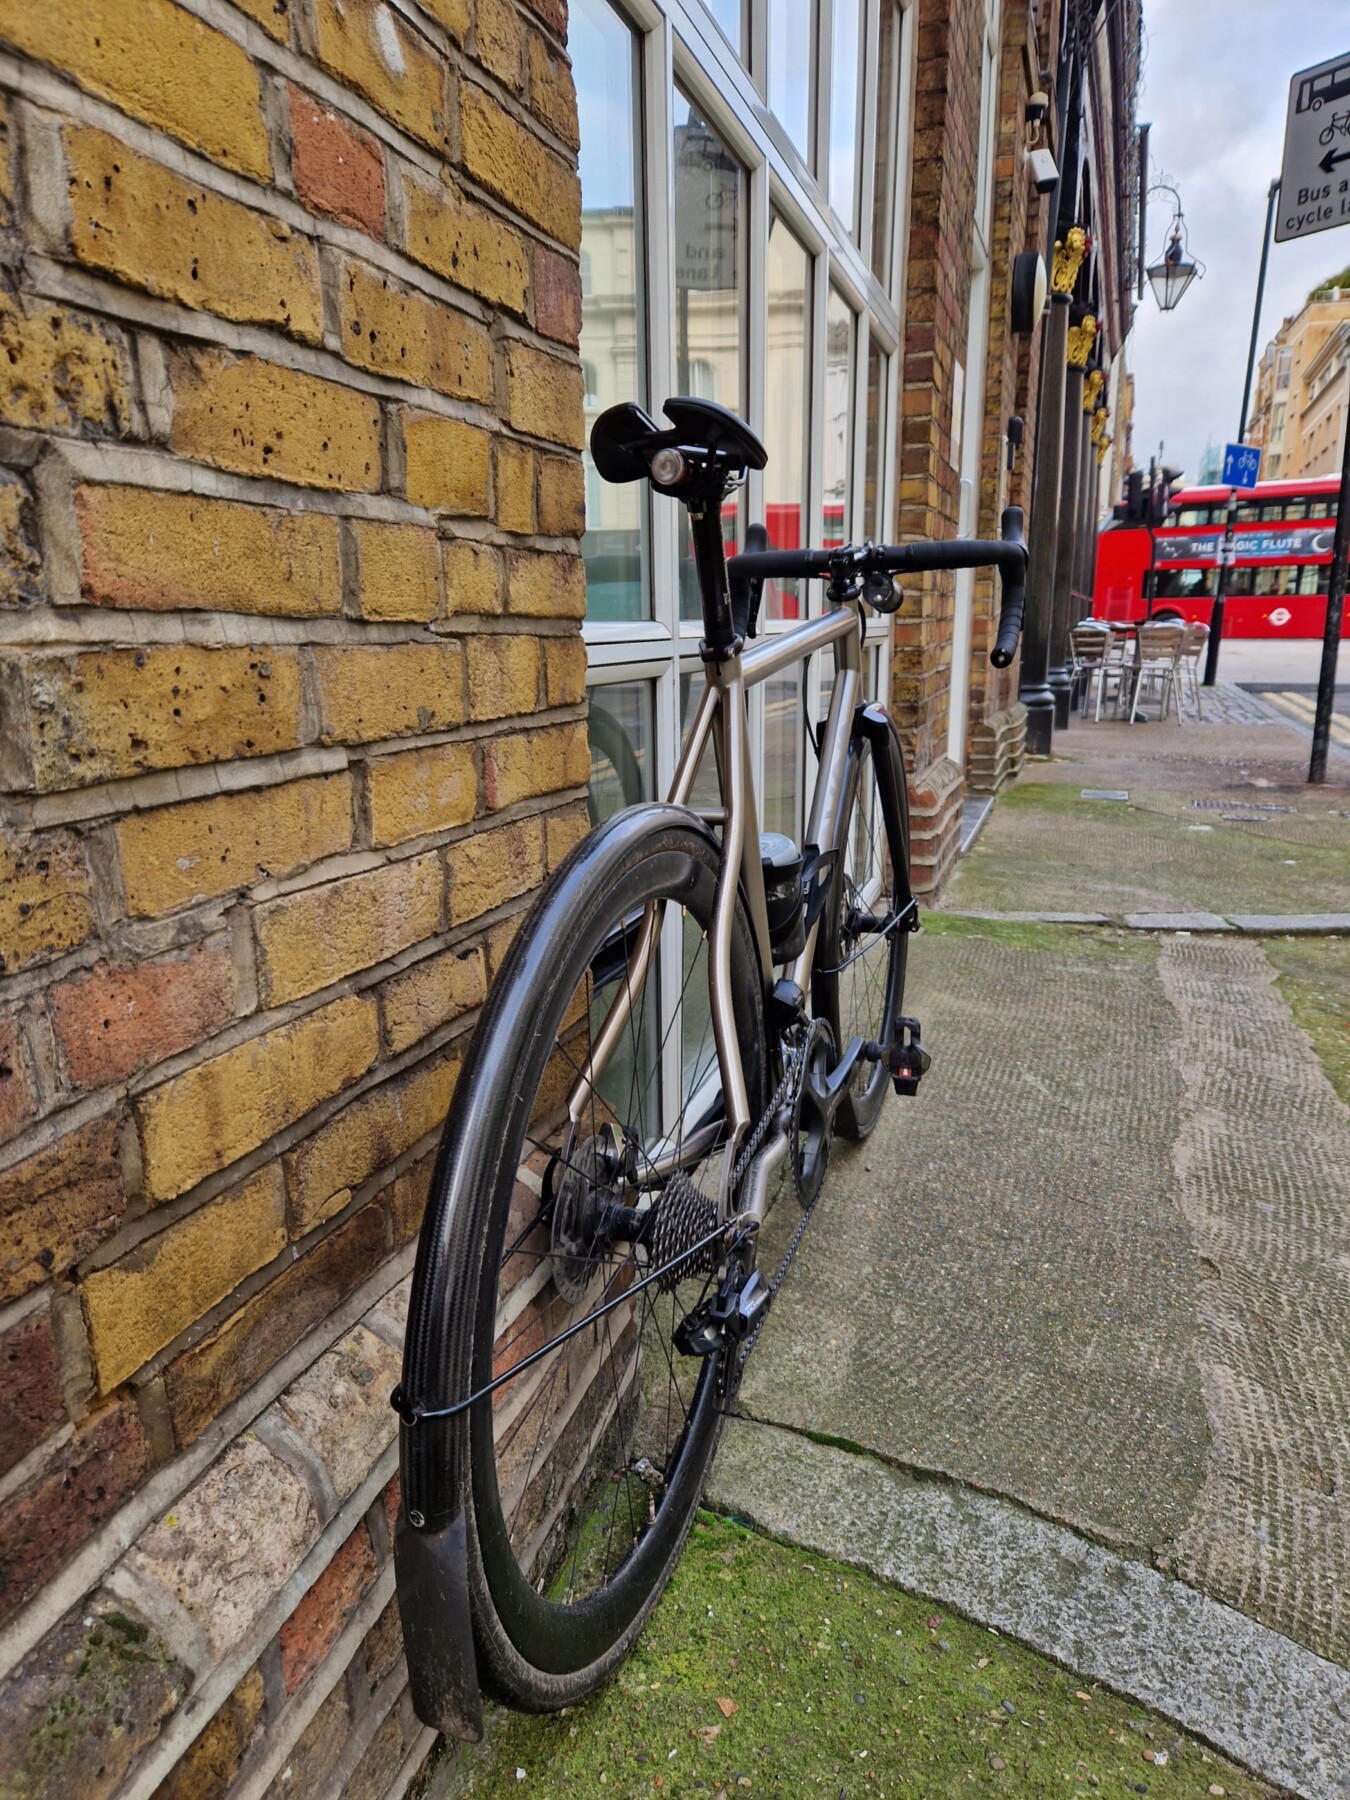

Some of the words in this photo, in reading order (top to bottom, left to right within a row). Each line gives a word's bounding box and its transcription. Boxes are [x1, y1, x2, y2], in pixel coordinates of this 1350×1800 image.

[1297, 184, 1331, 206] Bus
[1286, 204, 1333, 231] cycle
[1191, 541, 1215, 553] THE
[1232, 539, 1258, 551] GIC
[1261, 537, 1302, 549] FLUTE
